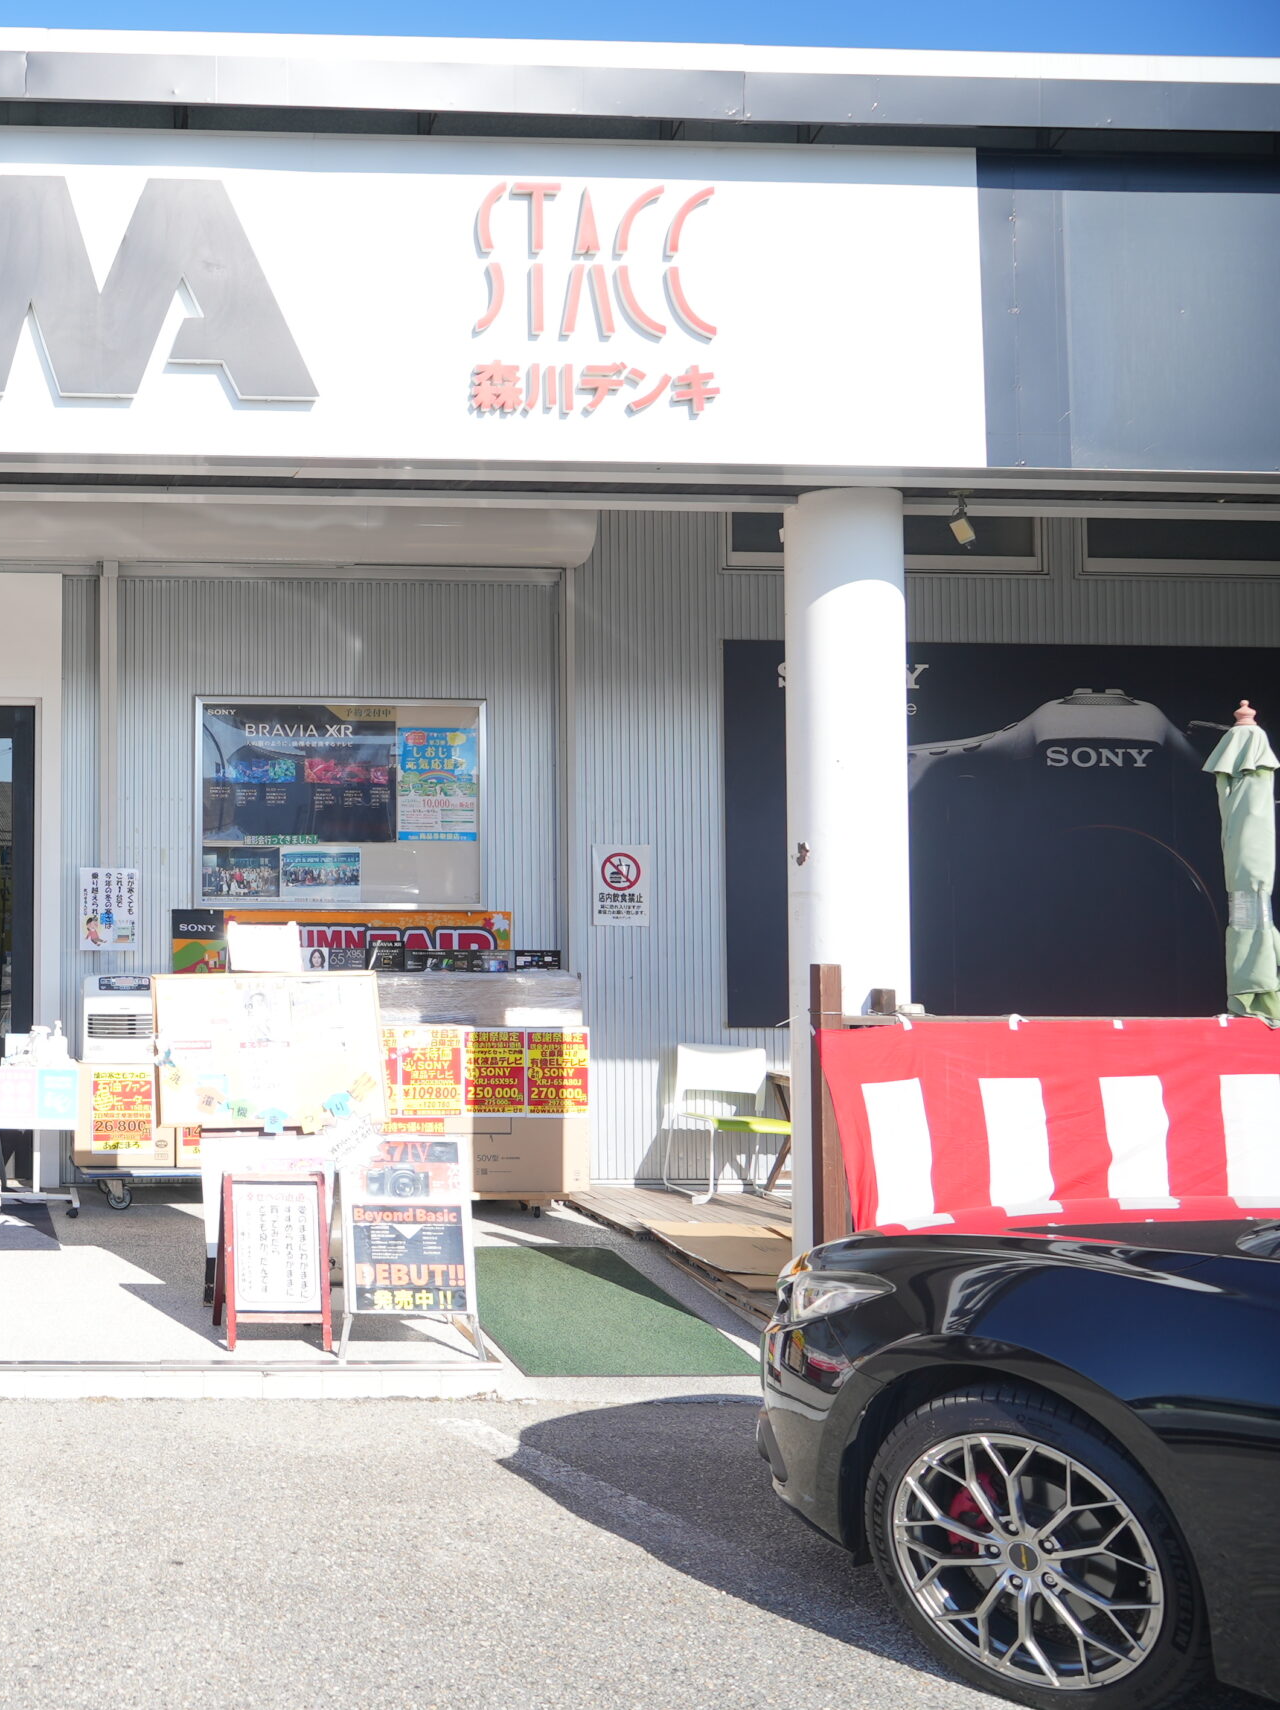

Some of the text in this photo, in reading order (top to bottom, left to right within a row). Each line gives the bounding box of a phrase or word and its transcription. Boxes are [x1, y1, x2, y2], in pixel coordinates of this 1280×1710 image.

[469, 359, 721, 416] 森川デンキ
[207, 708, 236, 716] SONY
[245, 723, 318, 738] BRAVIA
[1045, 746, 1154, 768] SONY
[598, 892, 644, 904] 店内飲食禁止
[179, 923, 217, 932] SONY
[417, 1061, 450, 1070] SONY
[466, 1057, 523, 1066] 4K液晶テレビ
[530, 1058, 586, 1068] 有機ELテレビ
[411, 1070, 454, 1079] 液晶テレビ
[480, 1067, 511, 1077] SONY
[544, 1068, 574, 1077] SONY
[113, 1095, 152, 1106] ヒーター
[353, 1207, 458, 1223] Beyond Basic
[355, 1263, 466, 1287] DEBUT!!
